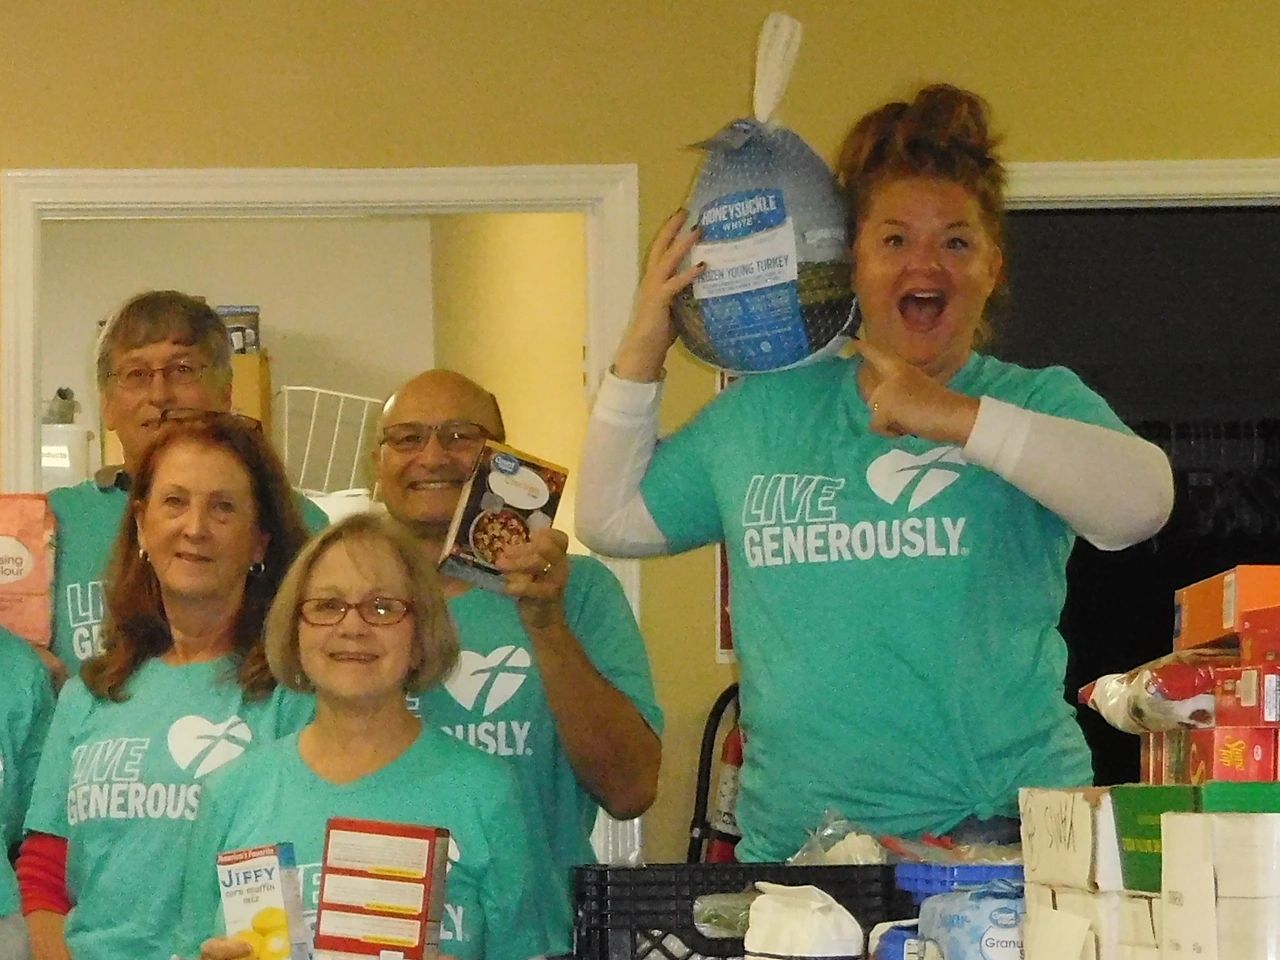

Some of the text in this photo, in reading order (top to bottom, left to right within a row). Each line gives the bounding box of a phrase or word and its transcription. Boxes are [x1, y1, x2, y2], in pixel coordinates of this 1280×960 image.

[701, 194, 777, 227] HONEYSUCKLE
[723, 216, 754, 232] WHITE
[727, 261, 755, 281] YOUNG
[756, 255, 790, 273] TURKEY
[742, 473, 846, 527] LIVE
[744, 516, 967, 568] GENEROUSLY
